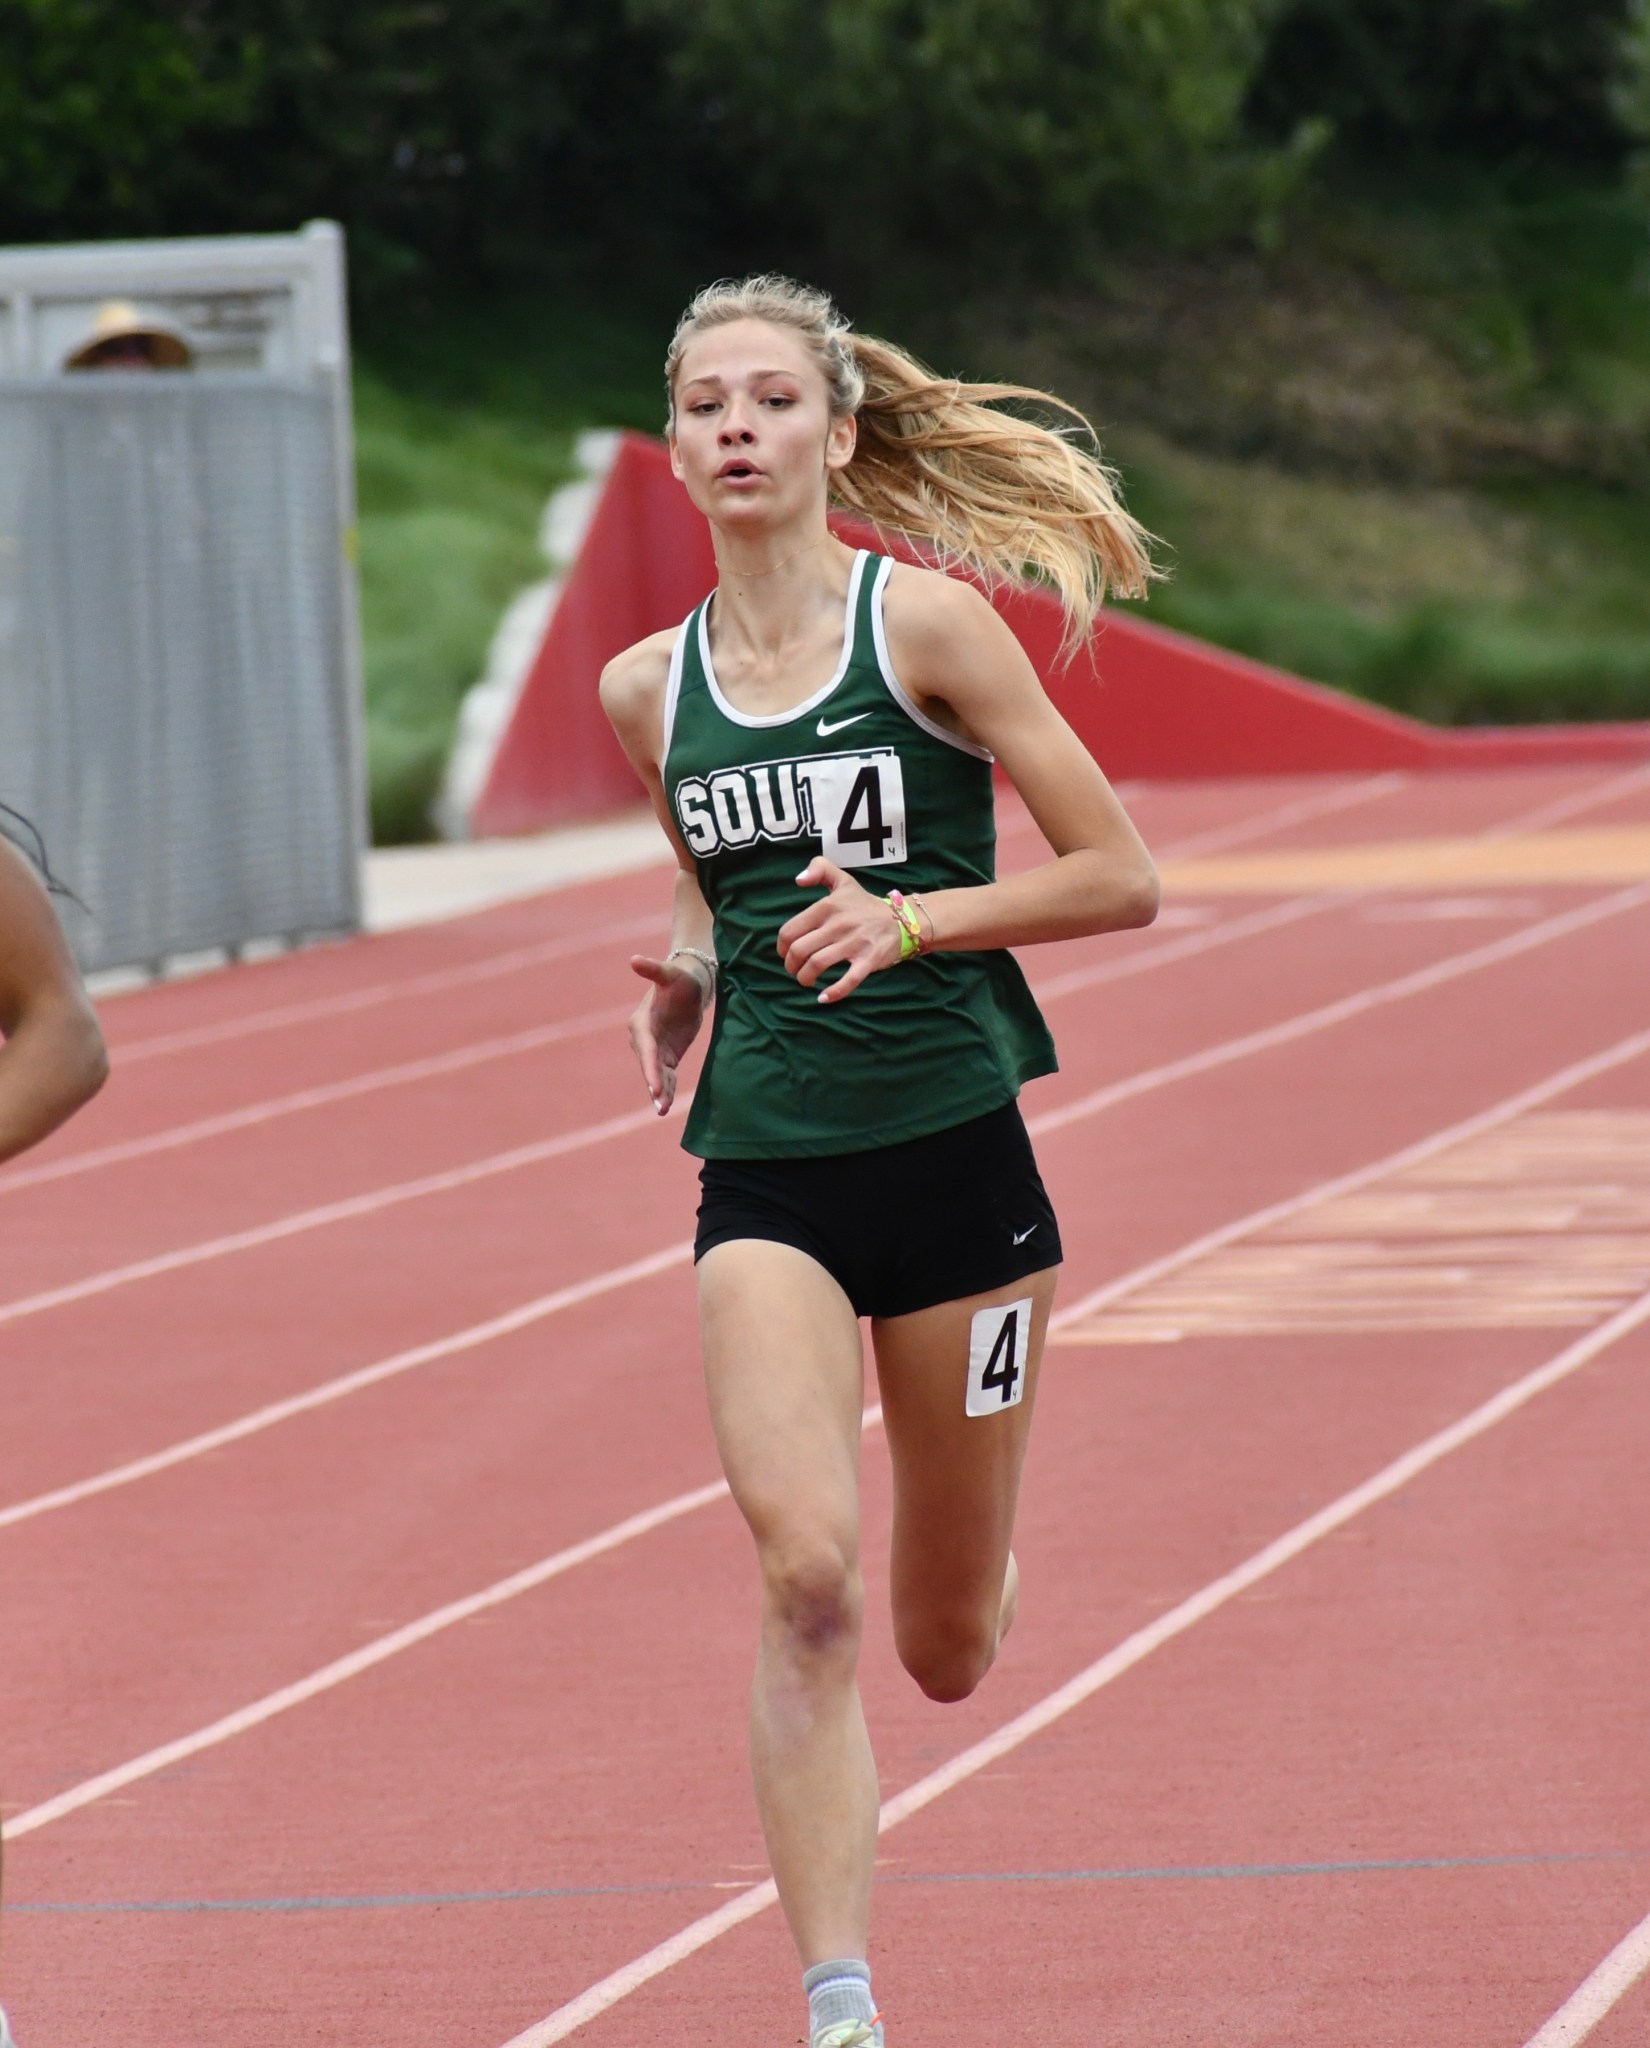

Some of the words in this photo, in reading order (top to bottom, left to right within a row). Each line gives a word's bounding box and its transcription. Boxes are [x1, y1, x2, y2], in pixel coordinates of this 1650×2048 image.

[837, 766, 892, 859] 4
[888, 847, 896, 857] 4
[981, 1309, 1019, 1403] 4
